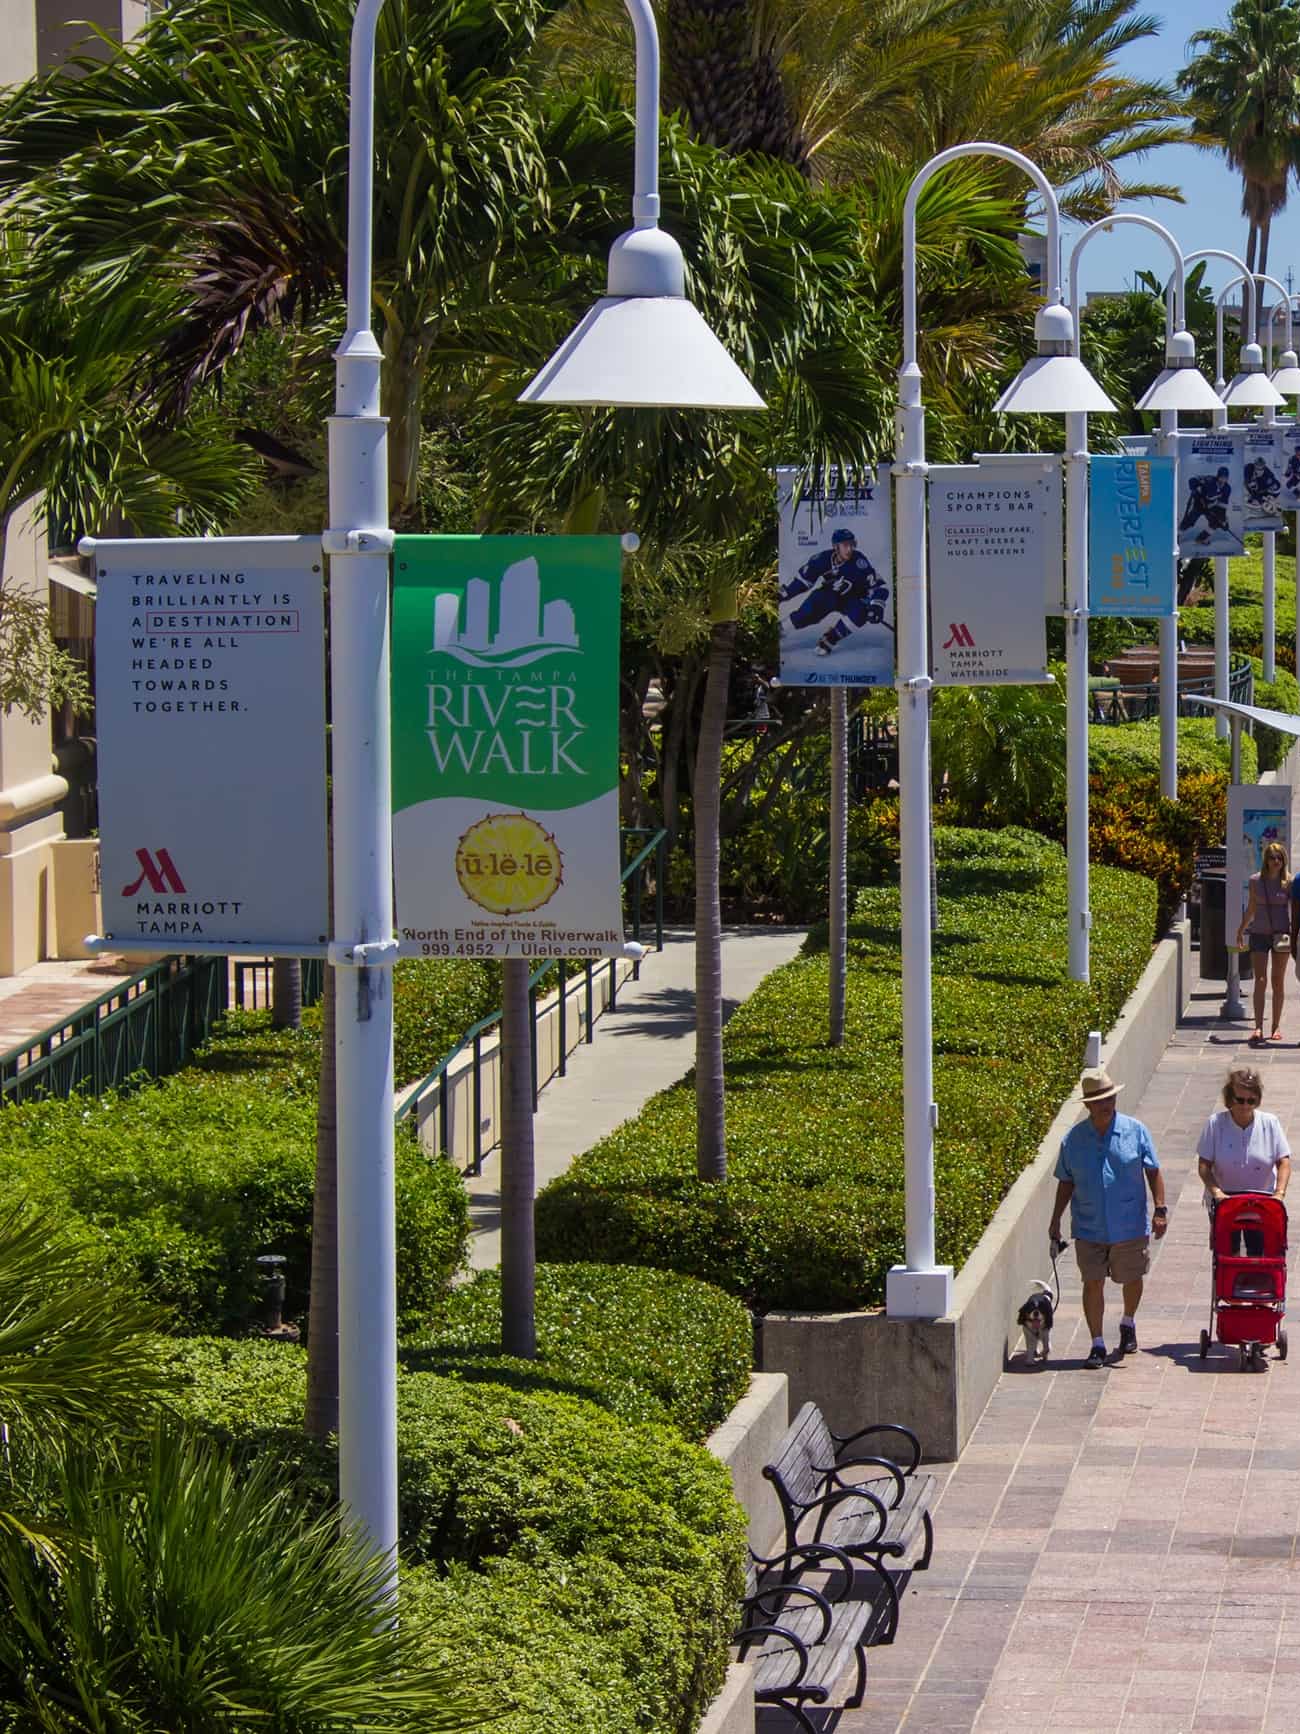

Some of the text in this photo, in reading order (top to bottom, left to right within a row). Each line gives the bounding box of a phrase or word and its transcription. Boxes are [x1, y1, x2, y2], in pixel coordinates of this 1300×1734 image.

[946, 490, 1031, 500] CHAMPIONS
[946, 502, 1034, 512] SPORTS BAR
[1114, 459, 1150, 590] RIVERFEST
[947, 527, 985, 535] CLASSIC
[947, 547, 1025, 557] HUGE SCREENS
[132, 574, 246, 585] TRAVELING
[132, 594, 291, 607] BRILLIANTLY IS
[132, 615, 292, 628] A DESTINATION
[132, 637, 240, 649] WE'RE ALL
[949, 649, 1004, 658] MARRIOTT
[132, 658, 213, 670] HEADED
[951, 660, 984, 668] TAMPA
[427, 670, 577, 682] THE TAMPA
[950, 669, 1009, 678] WATERSIDE
[132, 679, 229, 691] TOWARDS
[133, 700, 249, 713] TOGETHER.
[425, 684, 588, 729] RIVER
[424, 730, 589, 775] WALK
[136, 902, 242, 915] MARRIOTT
[137, 921, 203, 934] TAMPA
[405, 928, 619, 943] North End of the Riverwalk
[422, 943, 494, 956] 999.4952
[521, 943, 602, 956] Ulele.com
